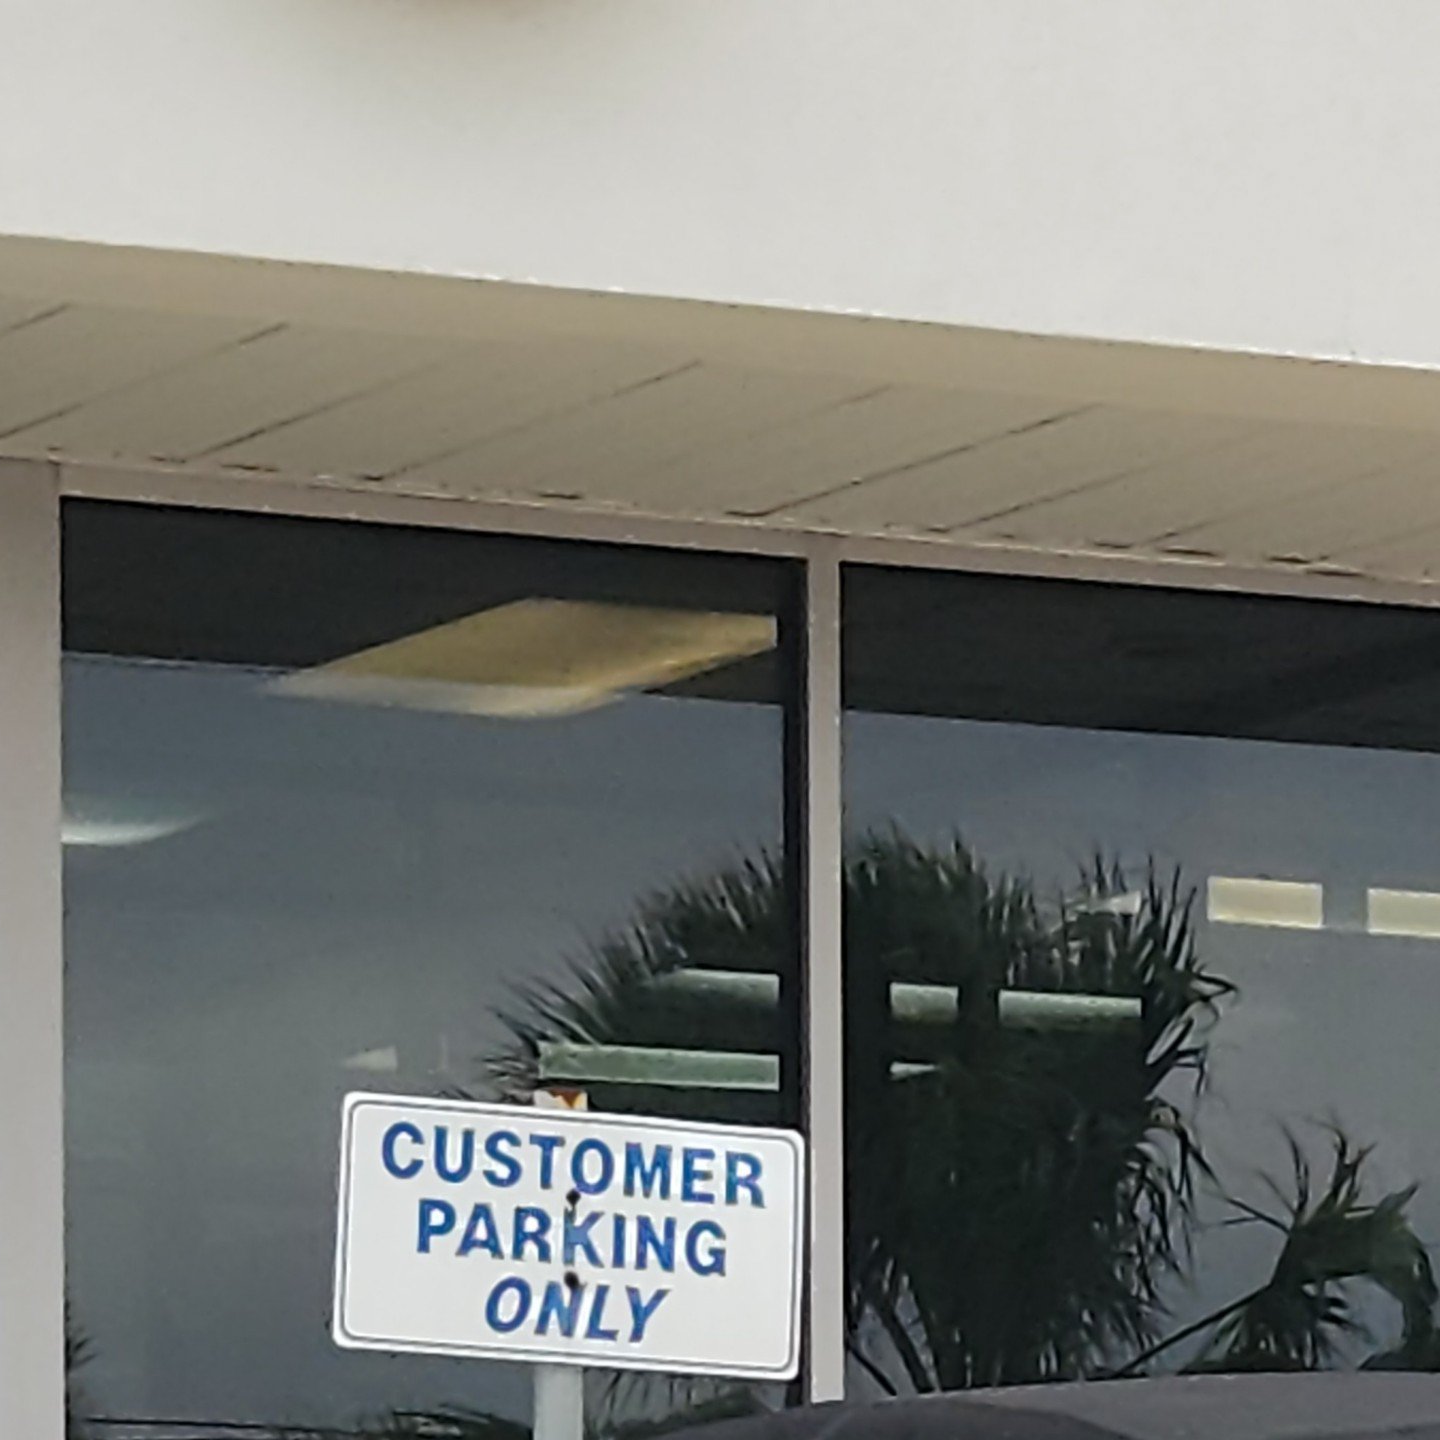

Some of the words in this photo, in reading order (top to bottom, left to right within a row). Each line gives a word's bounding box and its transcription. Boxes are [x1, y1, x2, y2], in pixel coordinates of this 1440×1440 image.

[381, 1121, 766, 1209] CUSTOMER
[416, 1197, 727, 1278] PARKING
[485, 1275, 671, 1344] ONLY
